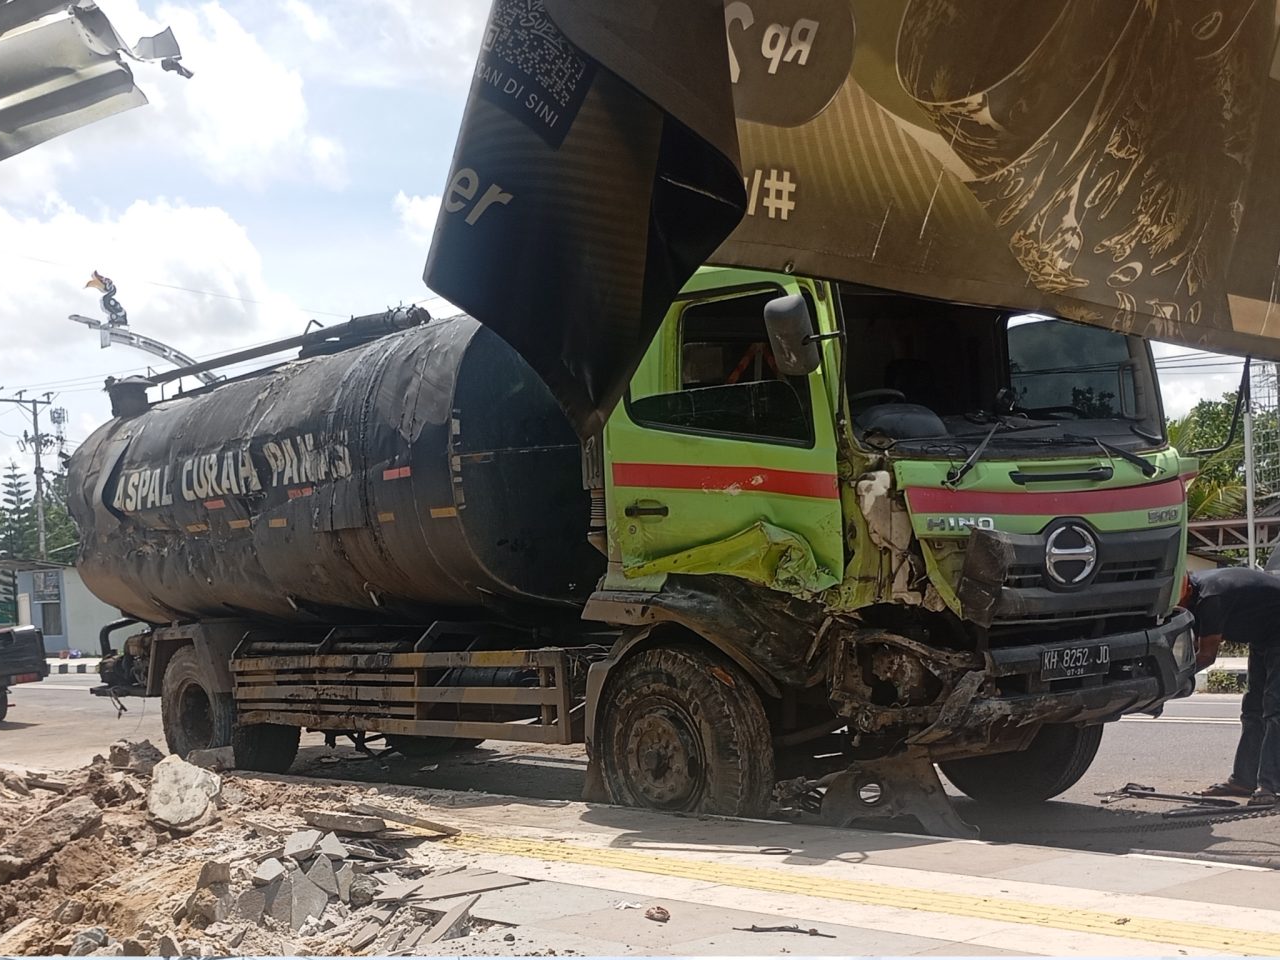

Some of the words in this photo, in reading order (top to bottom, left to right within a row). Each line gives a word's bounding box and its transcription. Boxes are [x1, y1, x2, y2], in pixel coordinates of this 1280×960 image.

[503, 78, 524, 99] DI
[525, 93, 559, 128] SINI
[445, 167, 514, 226] er
[113, 466, 173, 512] ASPAL
[181, 448, 263, 501] CURAH
[927, 517, 994, 531] HINO
[1043, 651, 1058, 670] KH
[1063, 648, 1089, 667] 8252
[1096, 646, 1109, 663] JD
